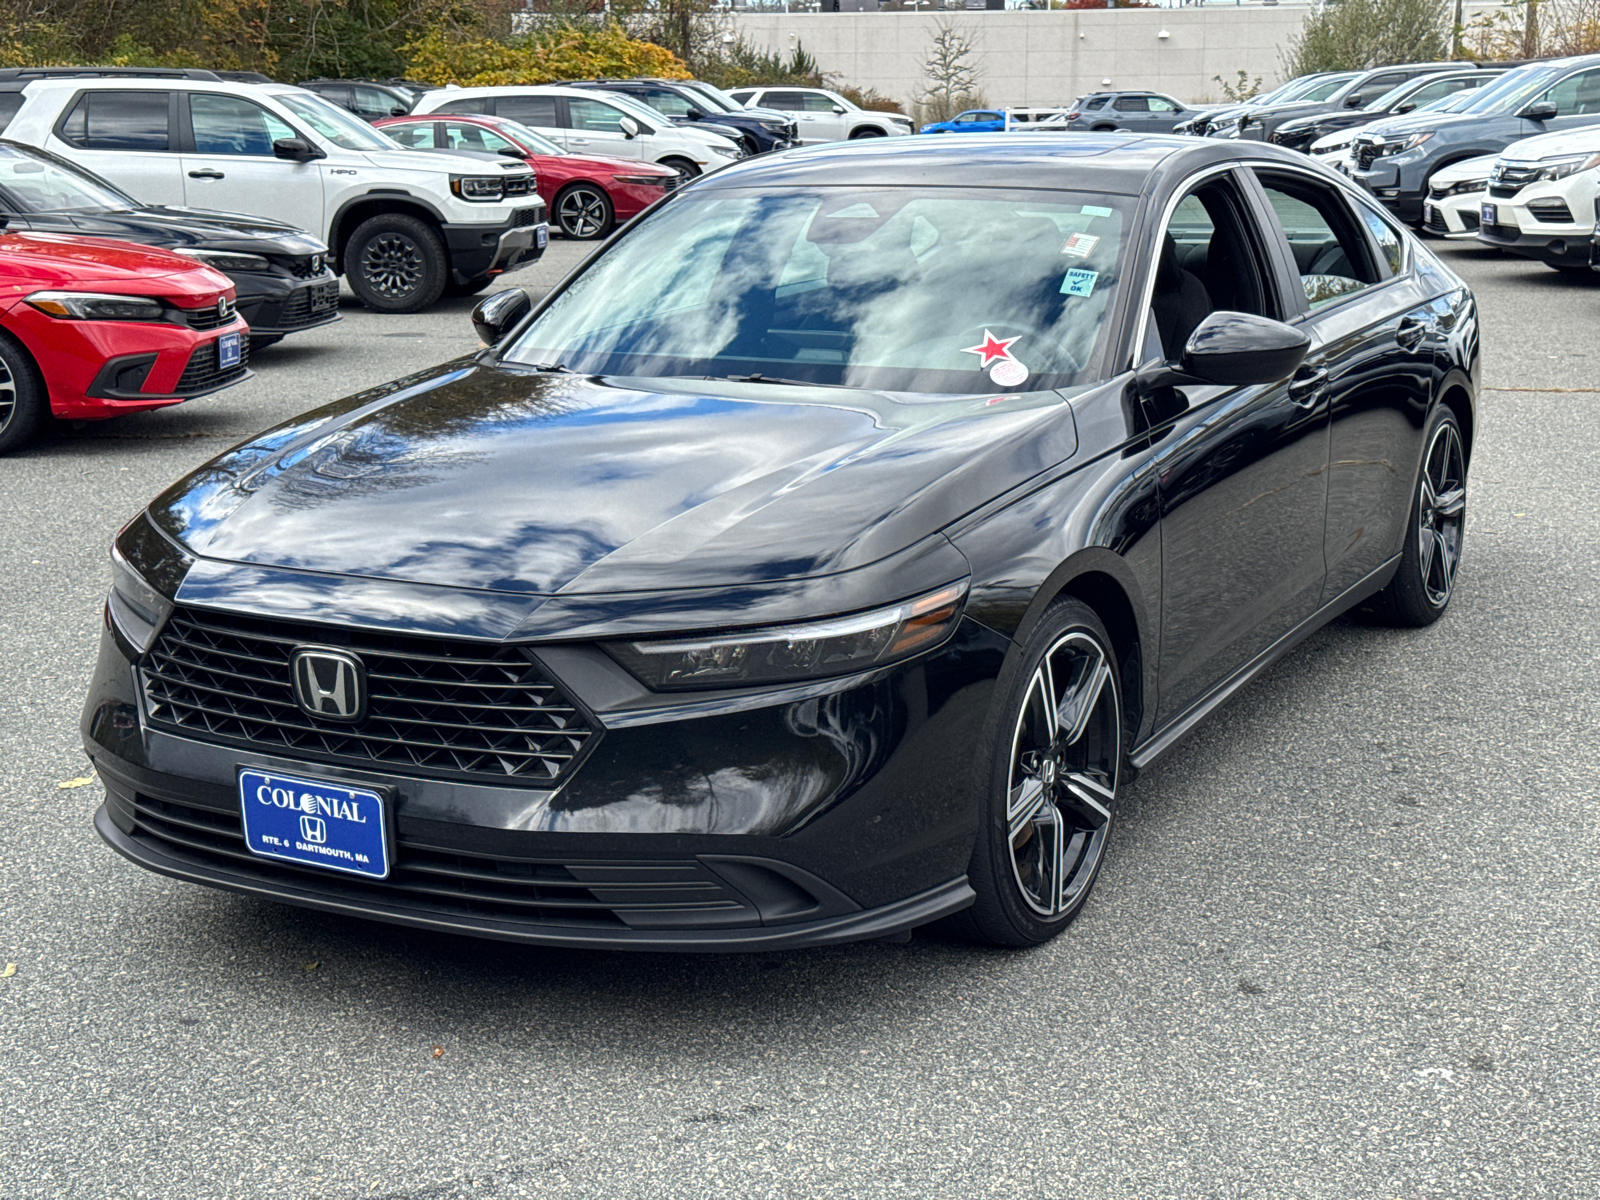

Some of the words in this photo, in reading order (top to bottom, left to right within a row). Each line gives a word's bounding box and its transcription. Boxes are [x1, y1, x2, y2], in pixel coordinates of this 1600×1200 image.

[1068, 271, 1095, 280] SAFETY
[1070, 285, 1083, 293] OK
[257, 786, 366, 823] COLONIAL
[262, 834, 282, 847] RTE.
[283, 840, 290, 848] 6
[295, 841, 354, 862] DARTMOUTH,
[355, 853, 370, 864] MA
